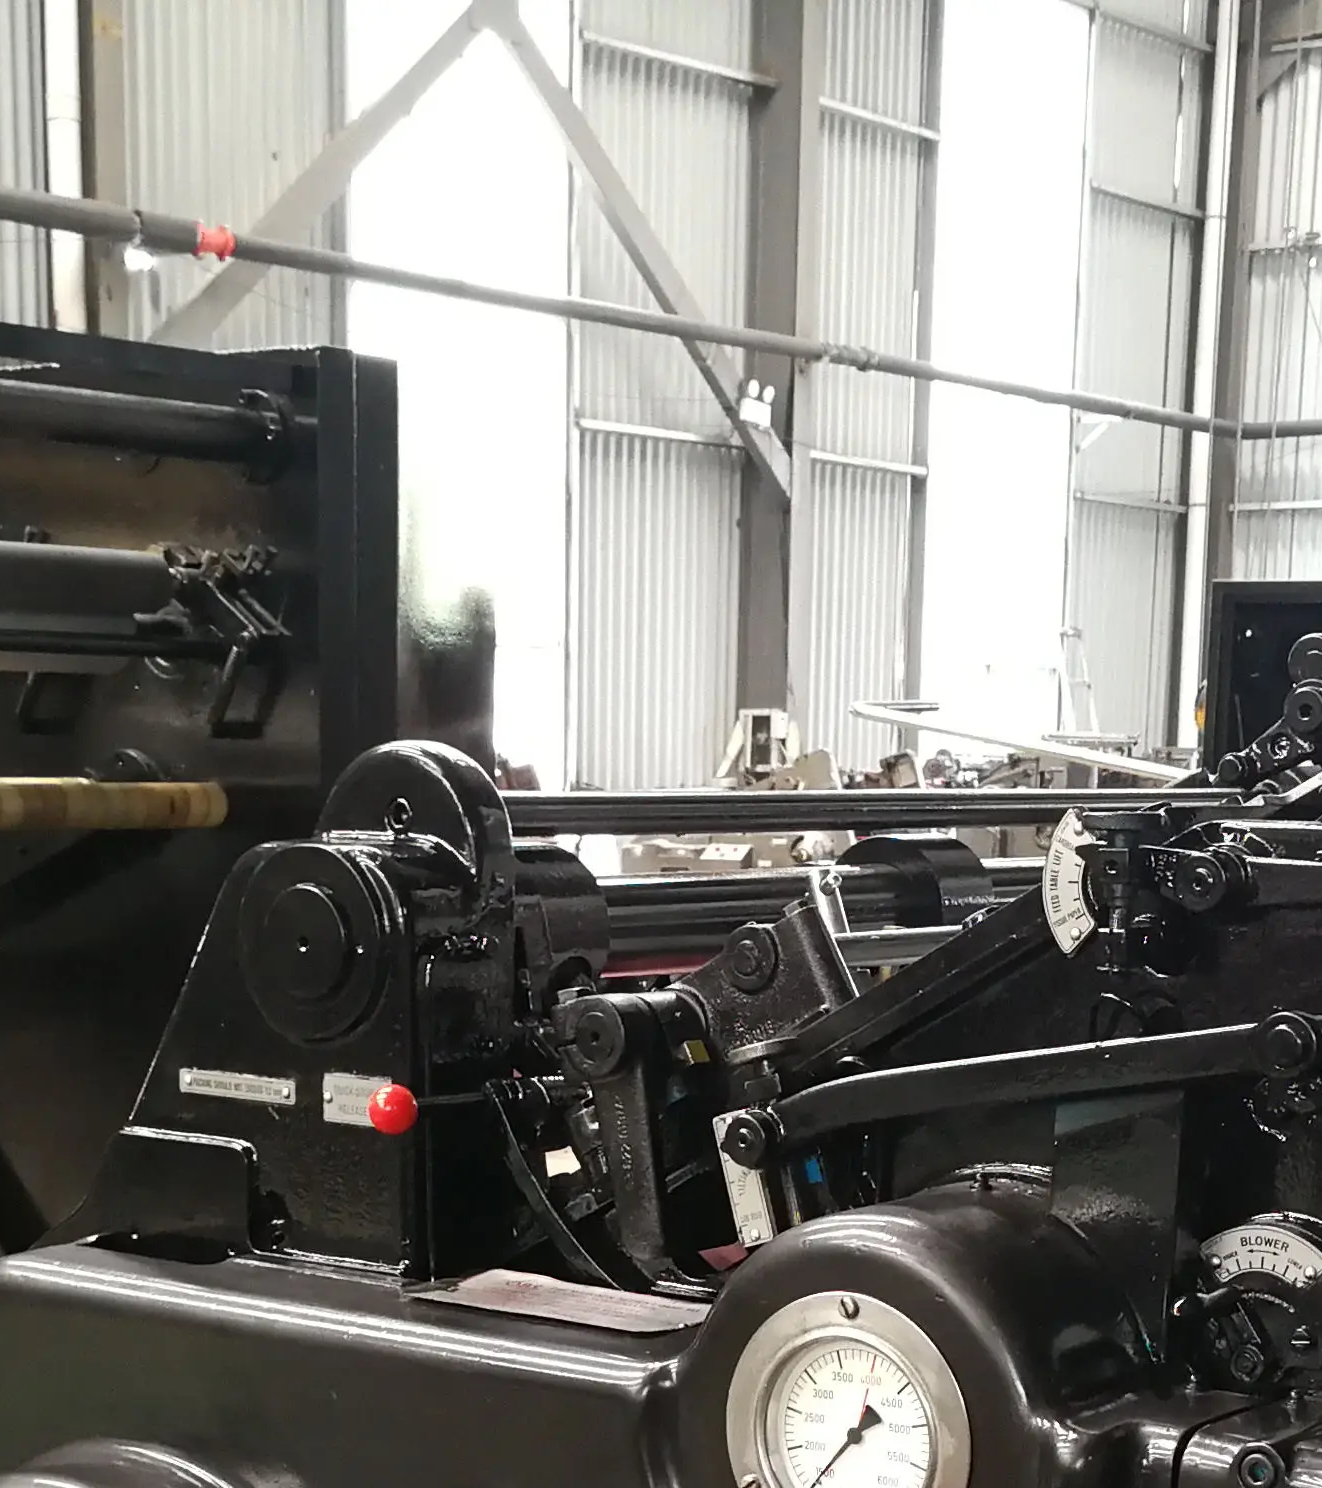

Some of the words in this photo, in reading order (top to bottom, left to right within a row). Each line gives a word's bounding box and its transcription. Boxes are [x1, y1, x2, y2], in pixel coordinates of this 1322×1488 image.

[1053, 851, 1064, 866] LIFT
[1050, 871, 1059, 892] TABLE
[1050, 894, 1061, 913] FEED
[1240, 1236, 1290, 1253] BLOWER
[831, 1371, 854, 1383] 3500
[861, 1374, 882, 1386] 4000
[813, 1388, 834, 1399] 3000
[880, 1397, 903, 1409] 4500
[804, 1412, 825, 1424] 2500
[888, 1423, 911, 1435] 5000
[804, 1441, 826, 1452] 2000
[887, 1452, 910, 1464] 5500
[877, 1475, 899, 1487] 6000
